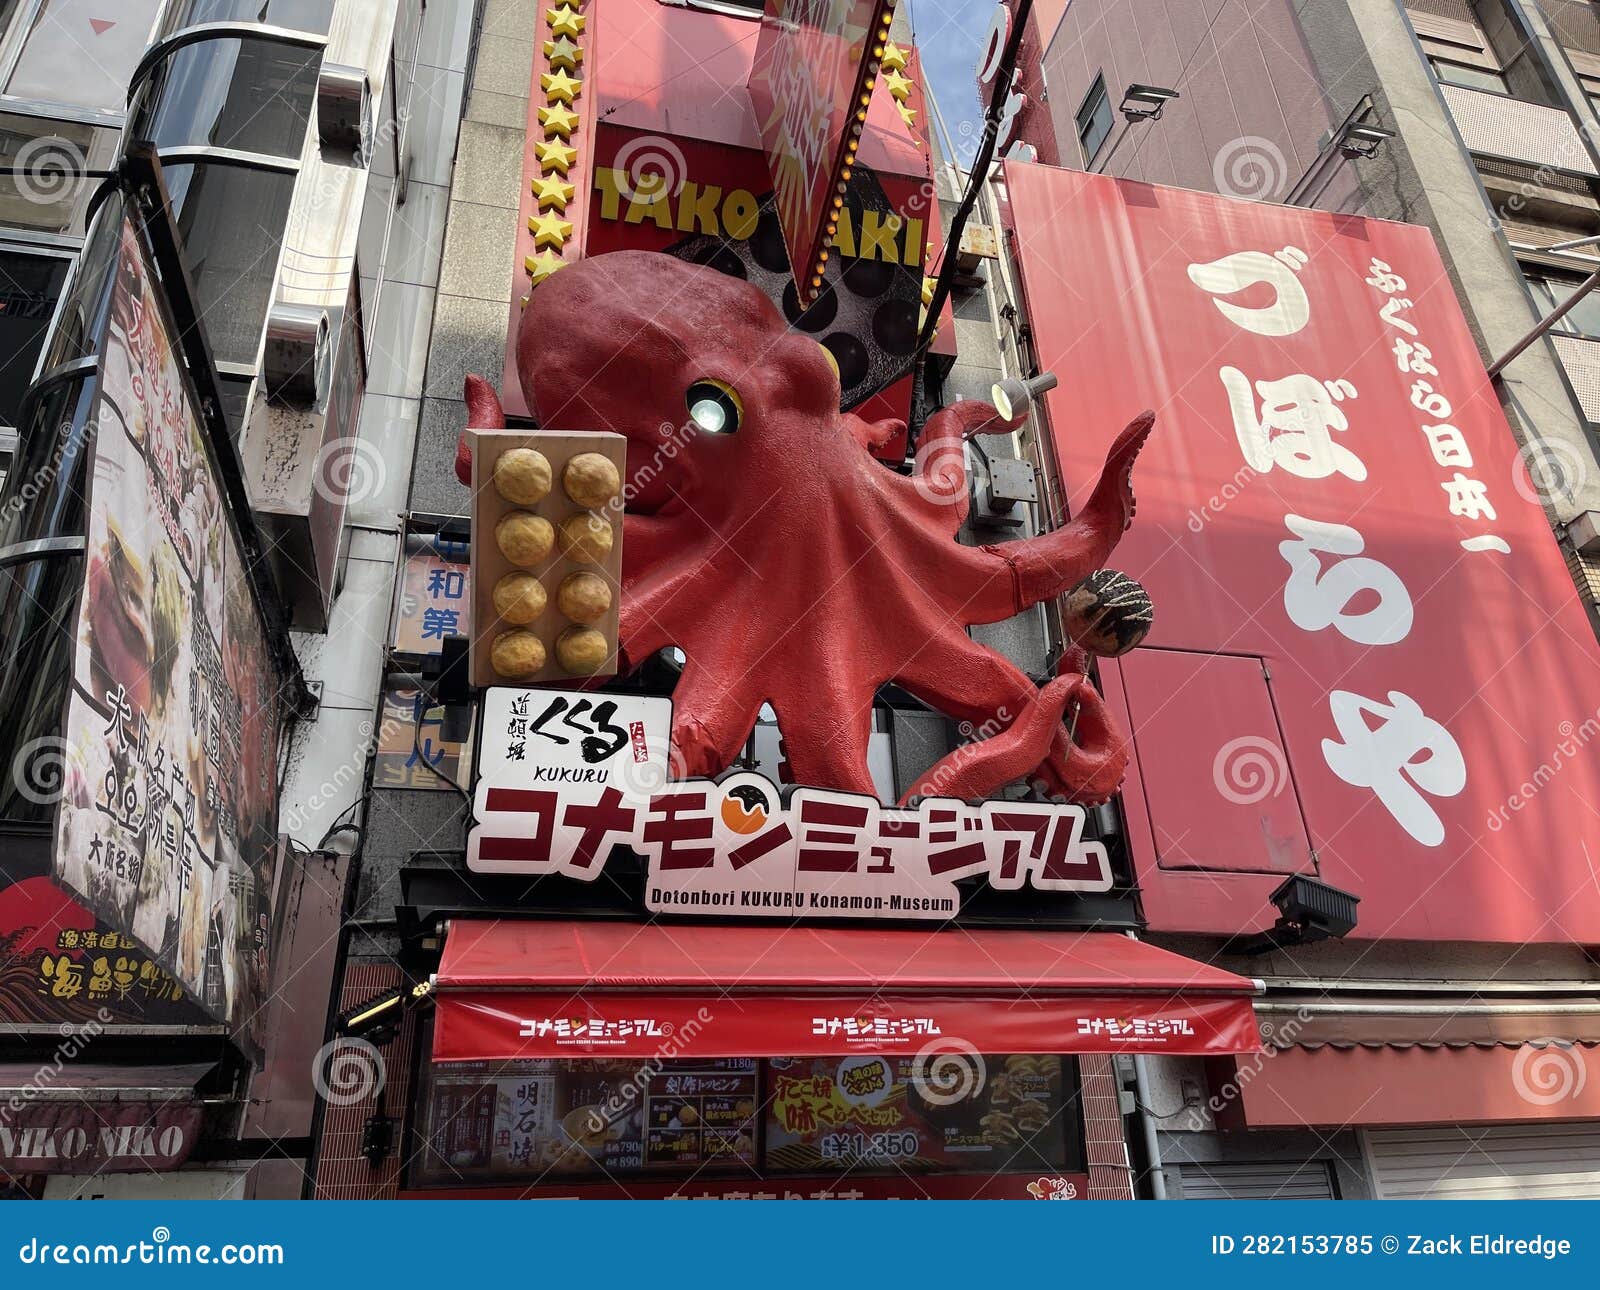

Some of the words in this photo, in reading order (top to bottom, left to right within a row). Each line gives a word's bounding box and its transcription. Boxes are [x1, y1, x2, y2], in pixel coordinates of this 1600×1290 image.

[594, 167, 923, 267] TAKOAKI
[1364, 257, 1511, 554] ふぐなら日本一
[1187, 246, 1467, 847] づぼらや
[506, 693, 530, 762] 道頓堀
[529, 696, 629, 764] くくる
[533, 766, 608, 784] KUKURU
[479, 785, 1104, 882] コナモンミュージアム
[652, 888, 735, 906] Dotonbori
[740, 890, 803, 908] KUKURU
[809, 892, 953, 912] Konamon-Museum
[519, 1017, 662, 1037] コナモンミュージアム
[812, 1016, 941, 1035] コナモンミュージアム
[1077, 1017, 1194, 1035] コナモンミュージアム
